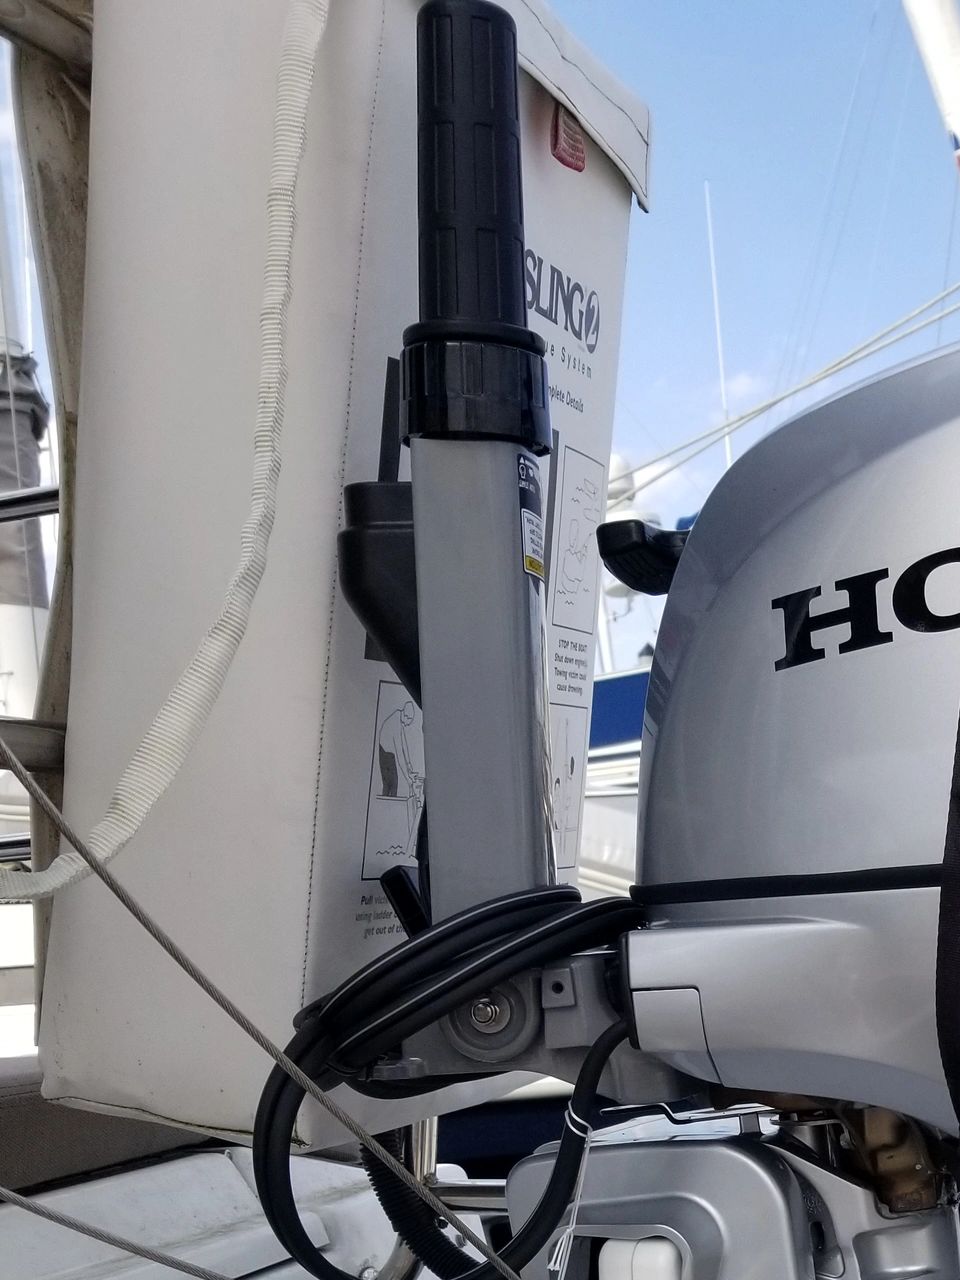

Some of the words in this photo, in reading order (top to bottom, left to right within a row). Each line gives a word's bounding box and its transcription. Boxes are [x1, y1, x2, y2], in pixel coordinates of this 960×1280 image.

[561, 346, 592, 379] System
[549, 386, 565, 404] plete
[566, 391, 584, 413] Details
[558, 639, 570, 649] STOP
[570, 641, 578, 652] THE
[554, 652, 564, 662] Shut
[360, 895, 374, 905] Pull
[375, 896, 389, 904] vict
[373, 910, 393, 920] ladder
[364, 927, 375, 939] get
[375, 926, 387, 935] out
[388, 924, 395, 934] of
[396, 925, 406, 933] th
